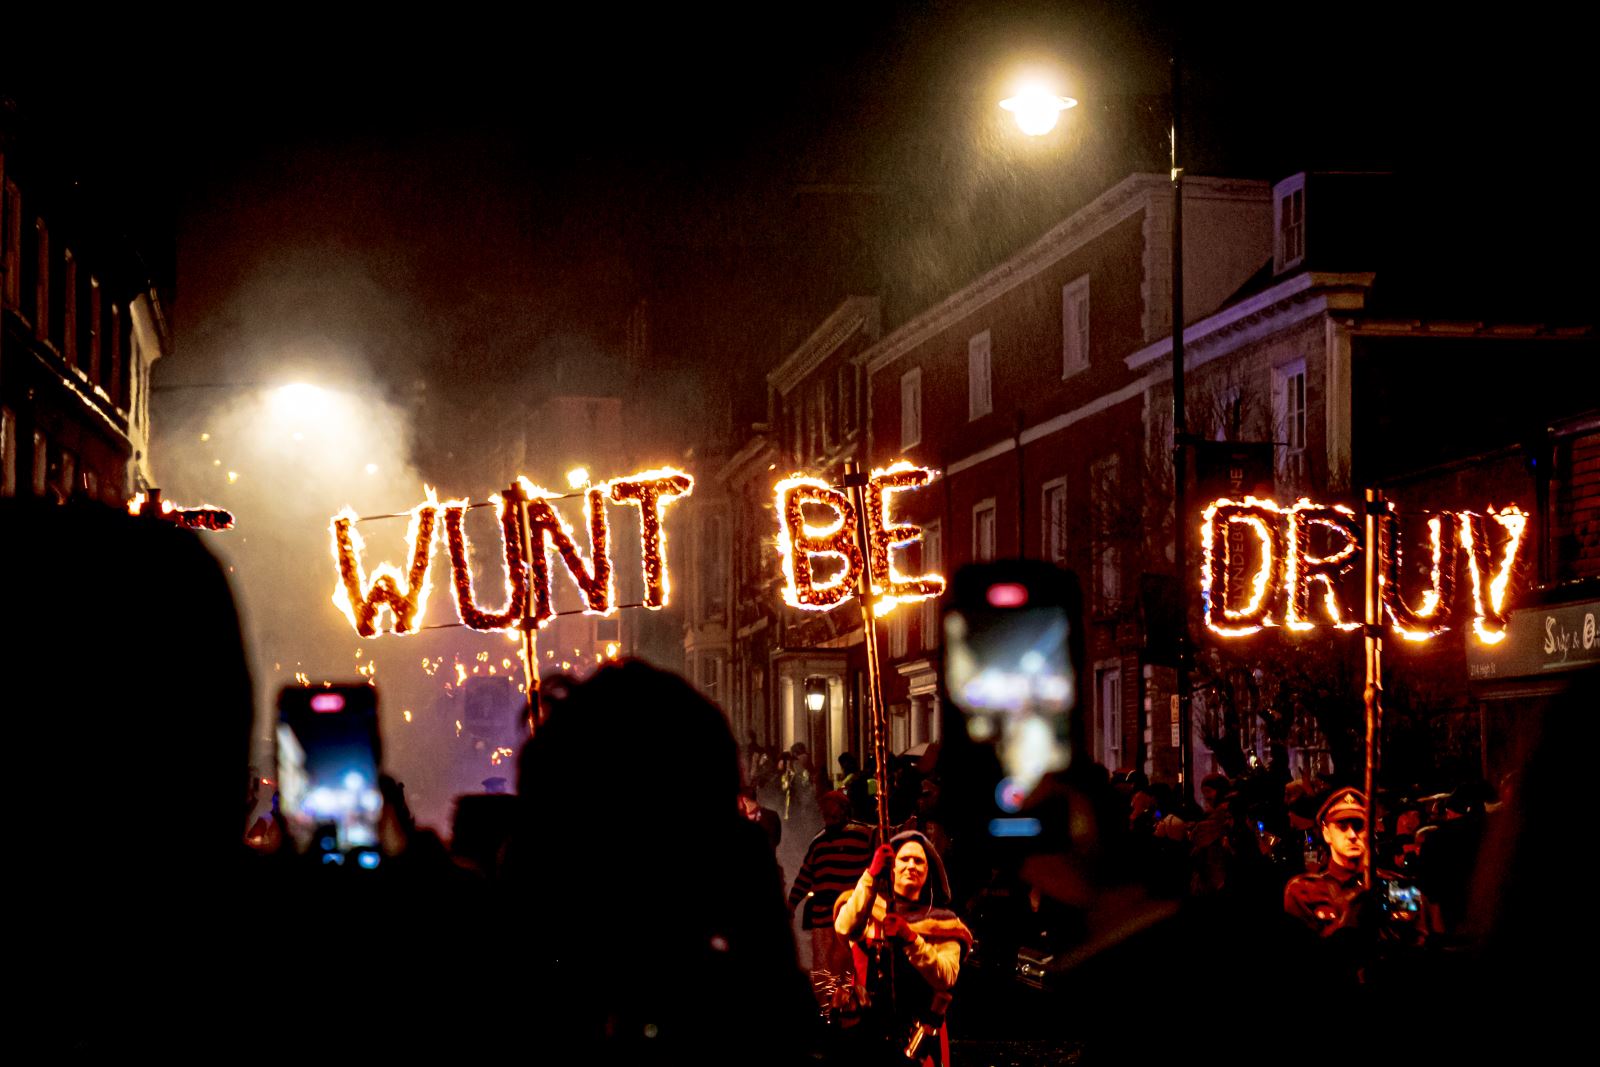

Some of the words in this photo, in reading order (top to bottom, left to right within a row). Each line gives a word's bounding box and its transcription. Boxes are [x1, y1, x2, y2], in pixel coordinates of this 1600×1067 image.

[332, 466, 694, 638] WUNT
[774, 462, 946, 614] BE
[1201, 496, 1530, 644] DRUV
